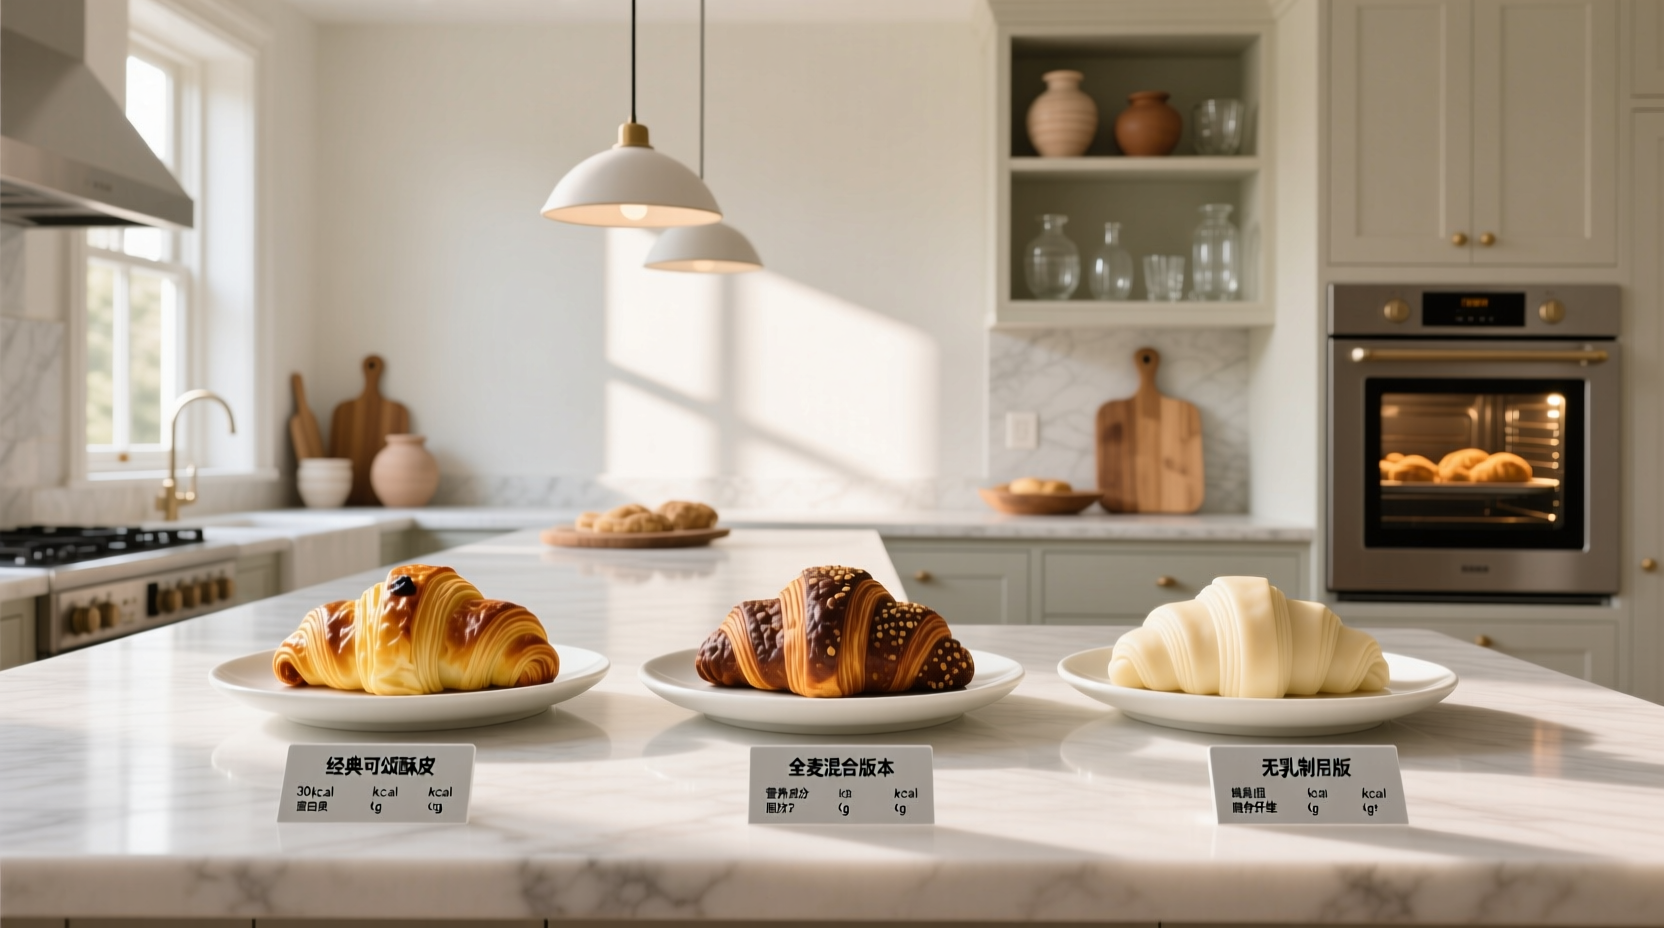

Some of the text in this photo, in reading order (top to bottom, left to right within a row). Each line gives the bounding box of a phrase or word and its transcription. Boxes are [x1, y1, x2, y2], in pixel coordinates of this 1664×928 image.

[788, 756, 895, 778] 全麦混合版本
[372, 785, 399, 798] kcal
[427, 785, 453, 798] kcal
[893, 787, 918, 799] kcal
[1361, 787, 1387, 799] kcal
